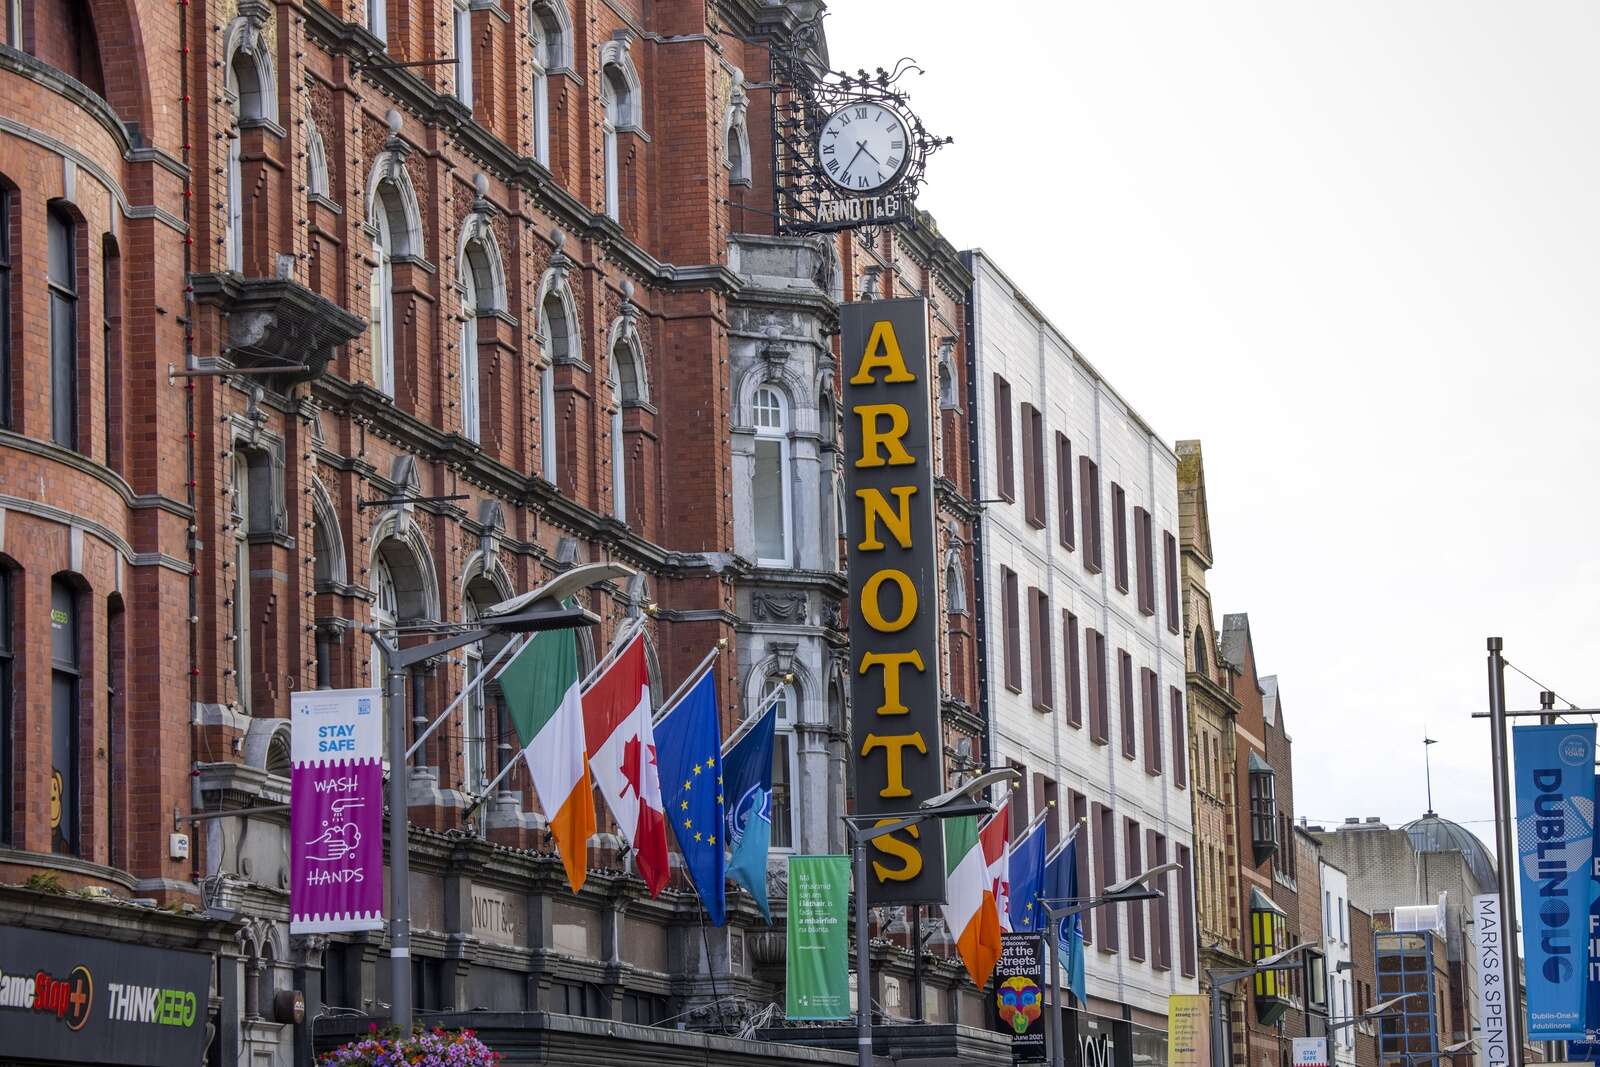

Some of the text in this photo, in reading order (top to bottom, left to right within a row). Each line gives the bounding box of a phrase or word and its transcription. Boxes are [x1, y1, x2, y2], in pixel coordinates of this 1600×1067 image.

[850, 320, 927, 884] ARNOTTS
[319, 724, 355, 738] STAY
[319, 739, 355, 752] SAFE
[314, 774, 359, 793] WASH
[307, 867, 364, 886] HANDS
[472, 895, 500, 931] NOTT
[1480, 900, 1499, 969] MARKS
[1014, 946, 1034, 956] the
[996, 965, 1041, 976] Festival!
[1484, 973, 1500, 986] &
[0, 971, 71, 1017] ameStop
